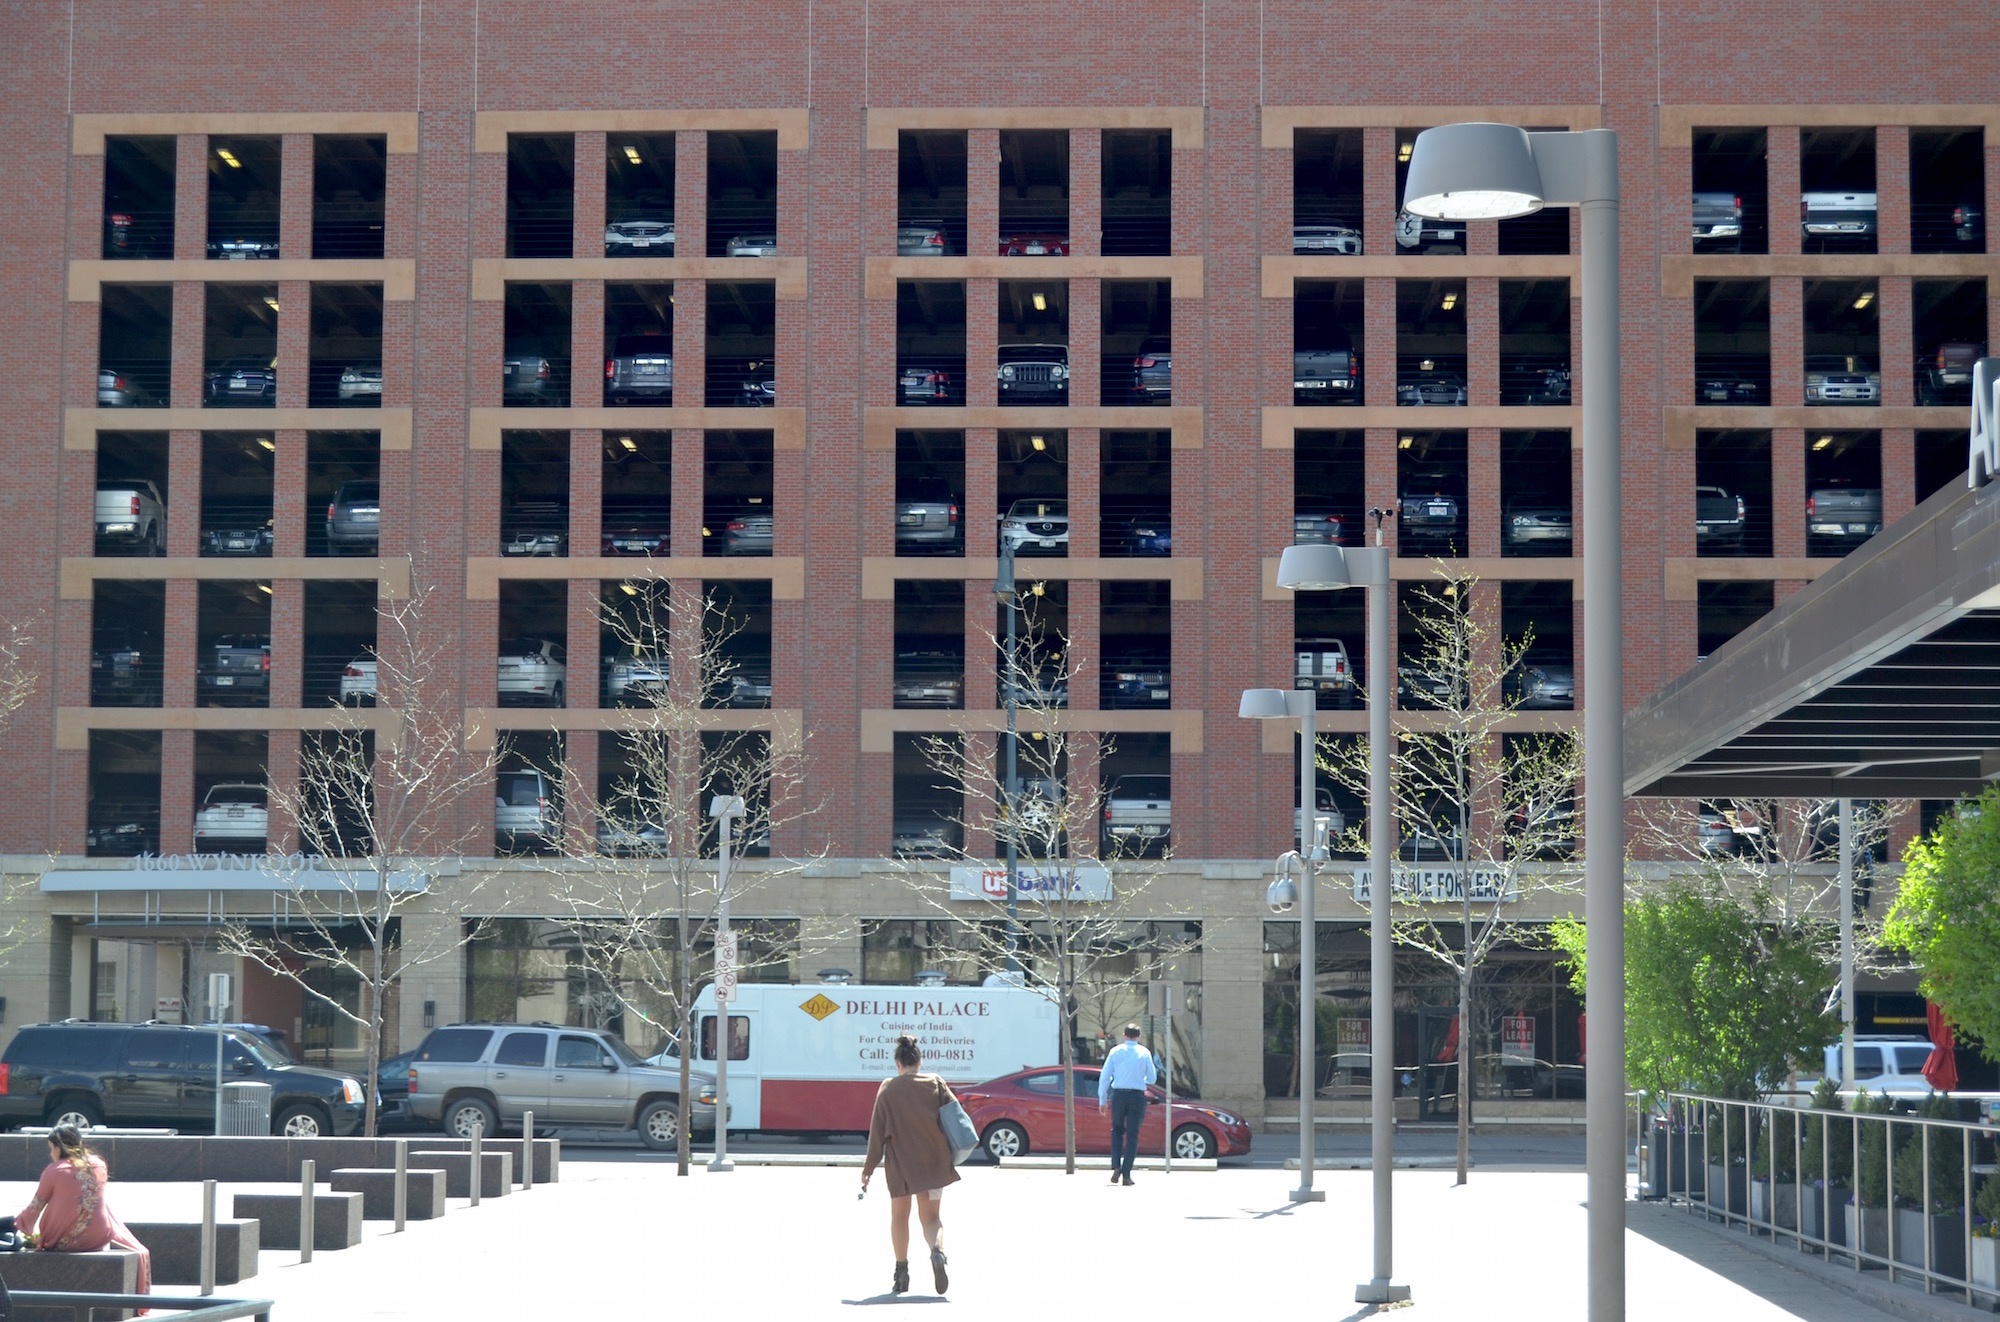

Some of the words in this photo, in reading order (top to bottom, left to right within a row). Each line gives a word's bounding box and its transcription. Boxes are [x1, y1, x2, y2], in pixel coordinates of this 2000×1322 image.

[133, 851, 180, 871] 1660
[186, 852, 324, 871] WYNKOOP
[1437, 872, 1464, 897] FOR
[846, 1000, 907, 1015] DELHI
[913, 1001, 990, 1017] PALACE
[881, 1021, 915, 1031] Cuisine
[917, 1022, 927, 1031] of
[929, 1022, 953, 1031] India
[1346, 1021, 1362, 1031] FOR
[1511, 1020, 1528, 1029] FOR
[859, 1034, 875, 1044] For
[931, 1036, 976, 1046] Deliveries
[1341, 1032, 1367, 1042] LEASE
[1506, 1031, 1532, 1040] LEASE
[859, 1048, 889, 1060] Call:
[919, 1049, 974, 1061] 400-0813
